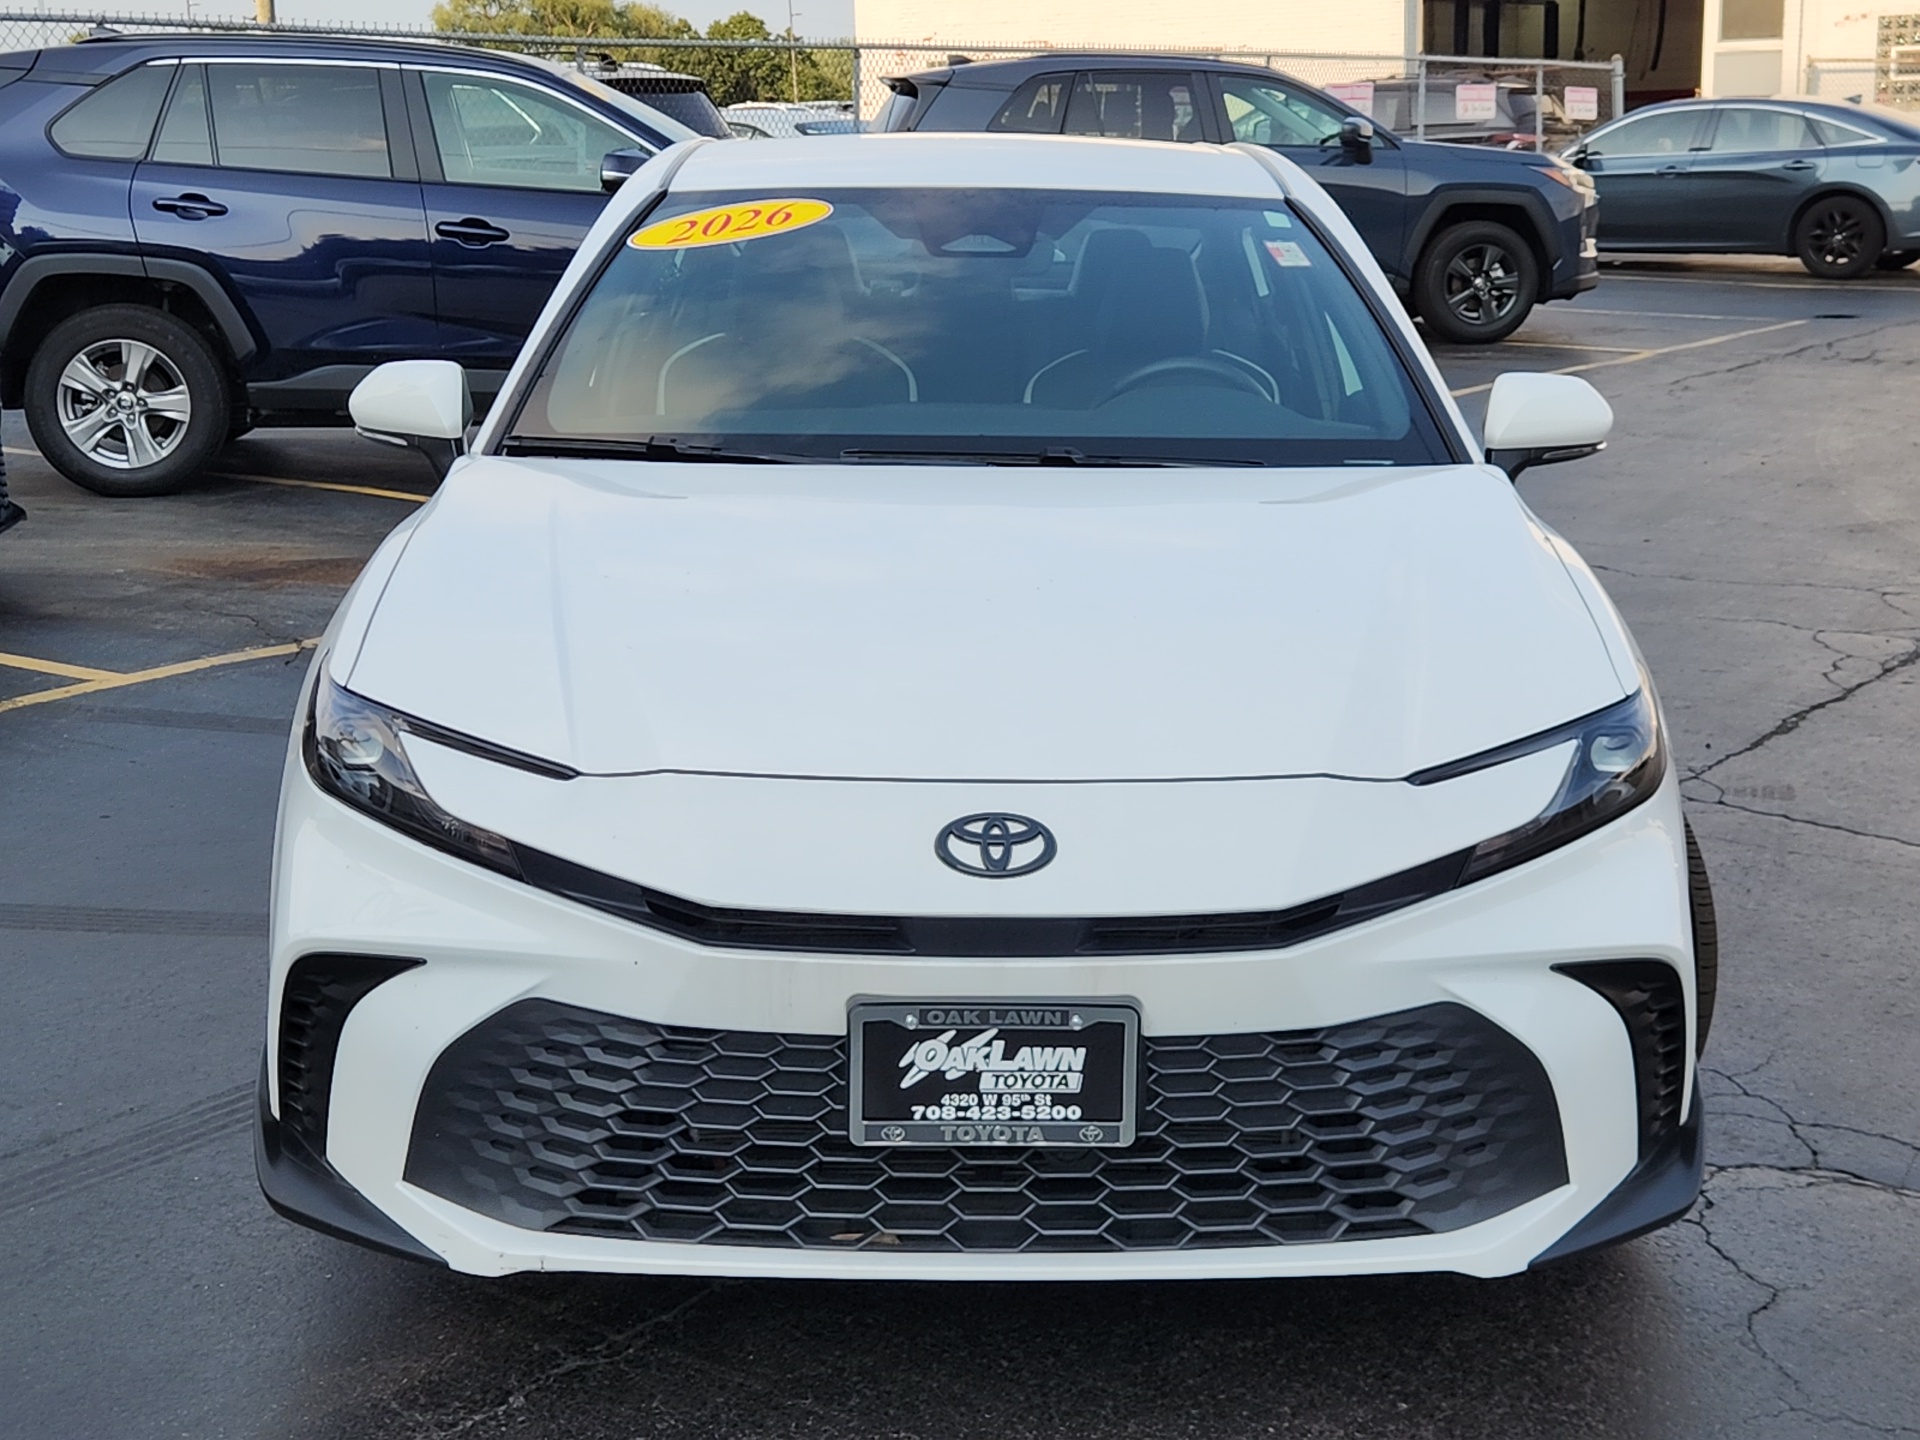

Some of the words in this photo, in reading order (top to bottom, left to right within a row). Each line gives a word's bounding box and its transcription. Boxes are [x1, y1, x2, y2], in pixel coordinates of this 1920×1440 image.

[666, 201, 799, 245] 2026
[926, 1010, 982, 1025] OAK
[988, 1010, 1062, 1025] LAWN
[991, 1073, 1070, 1090] TOYOTA
[940, 1093, 979, 1106] 4320
[981, 1093, 998, 1106] W
[1001, 1093, 1032, 1106] 95th
[1034, 1093, 1053, 1106] St
[910, 1105, 1083, 1121] 708-423-5200
[939, 1125, 1046, 1142] TOYOTA
